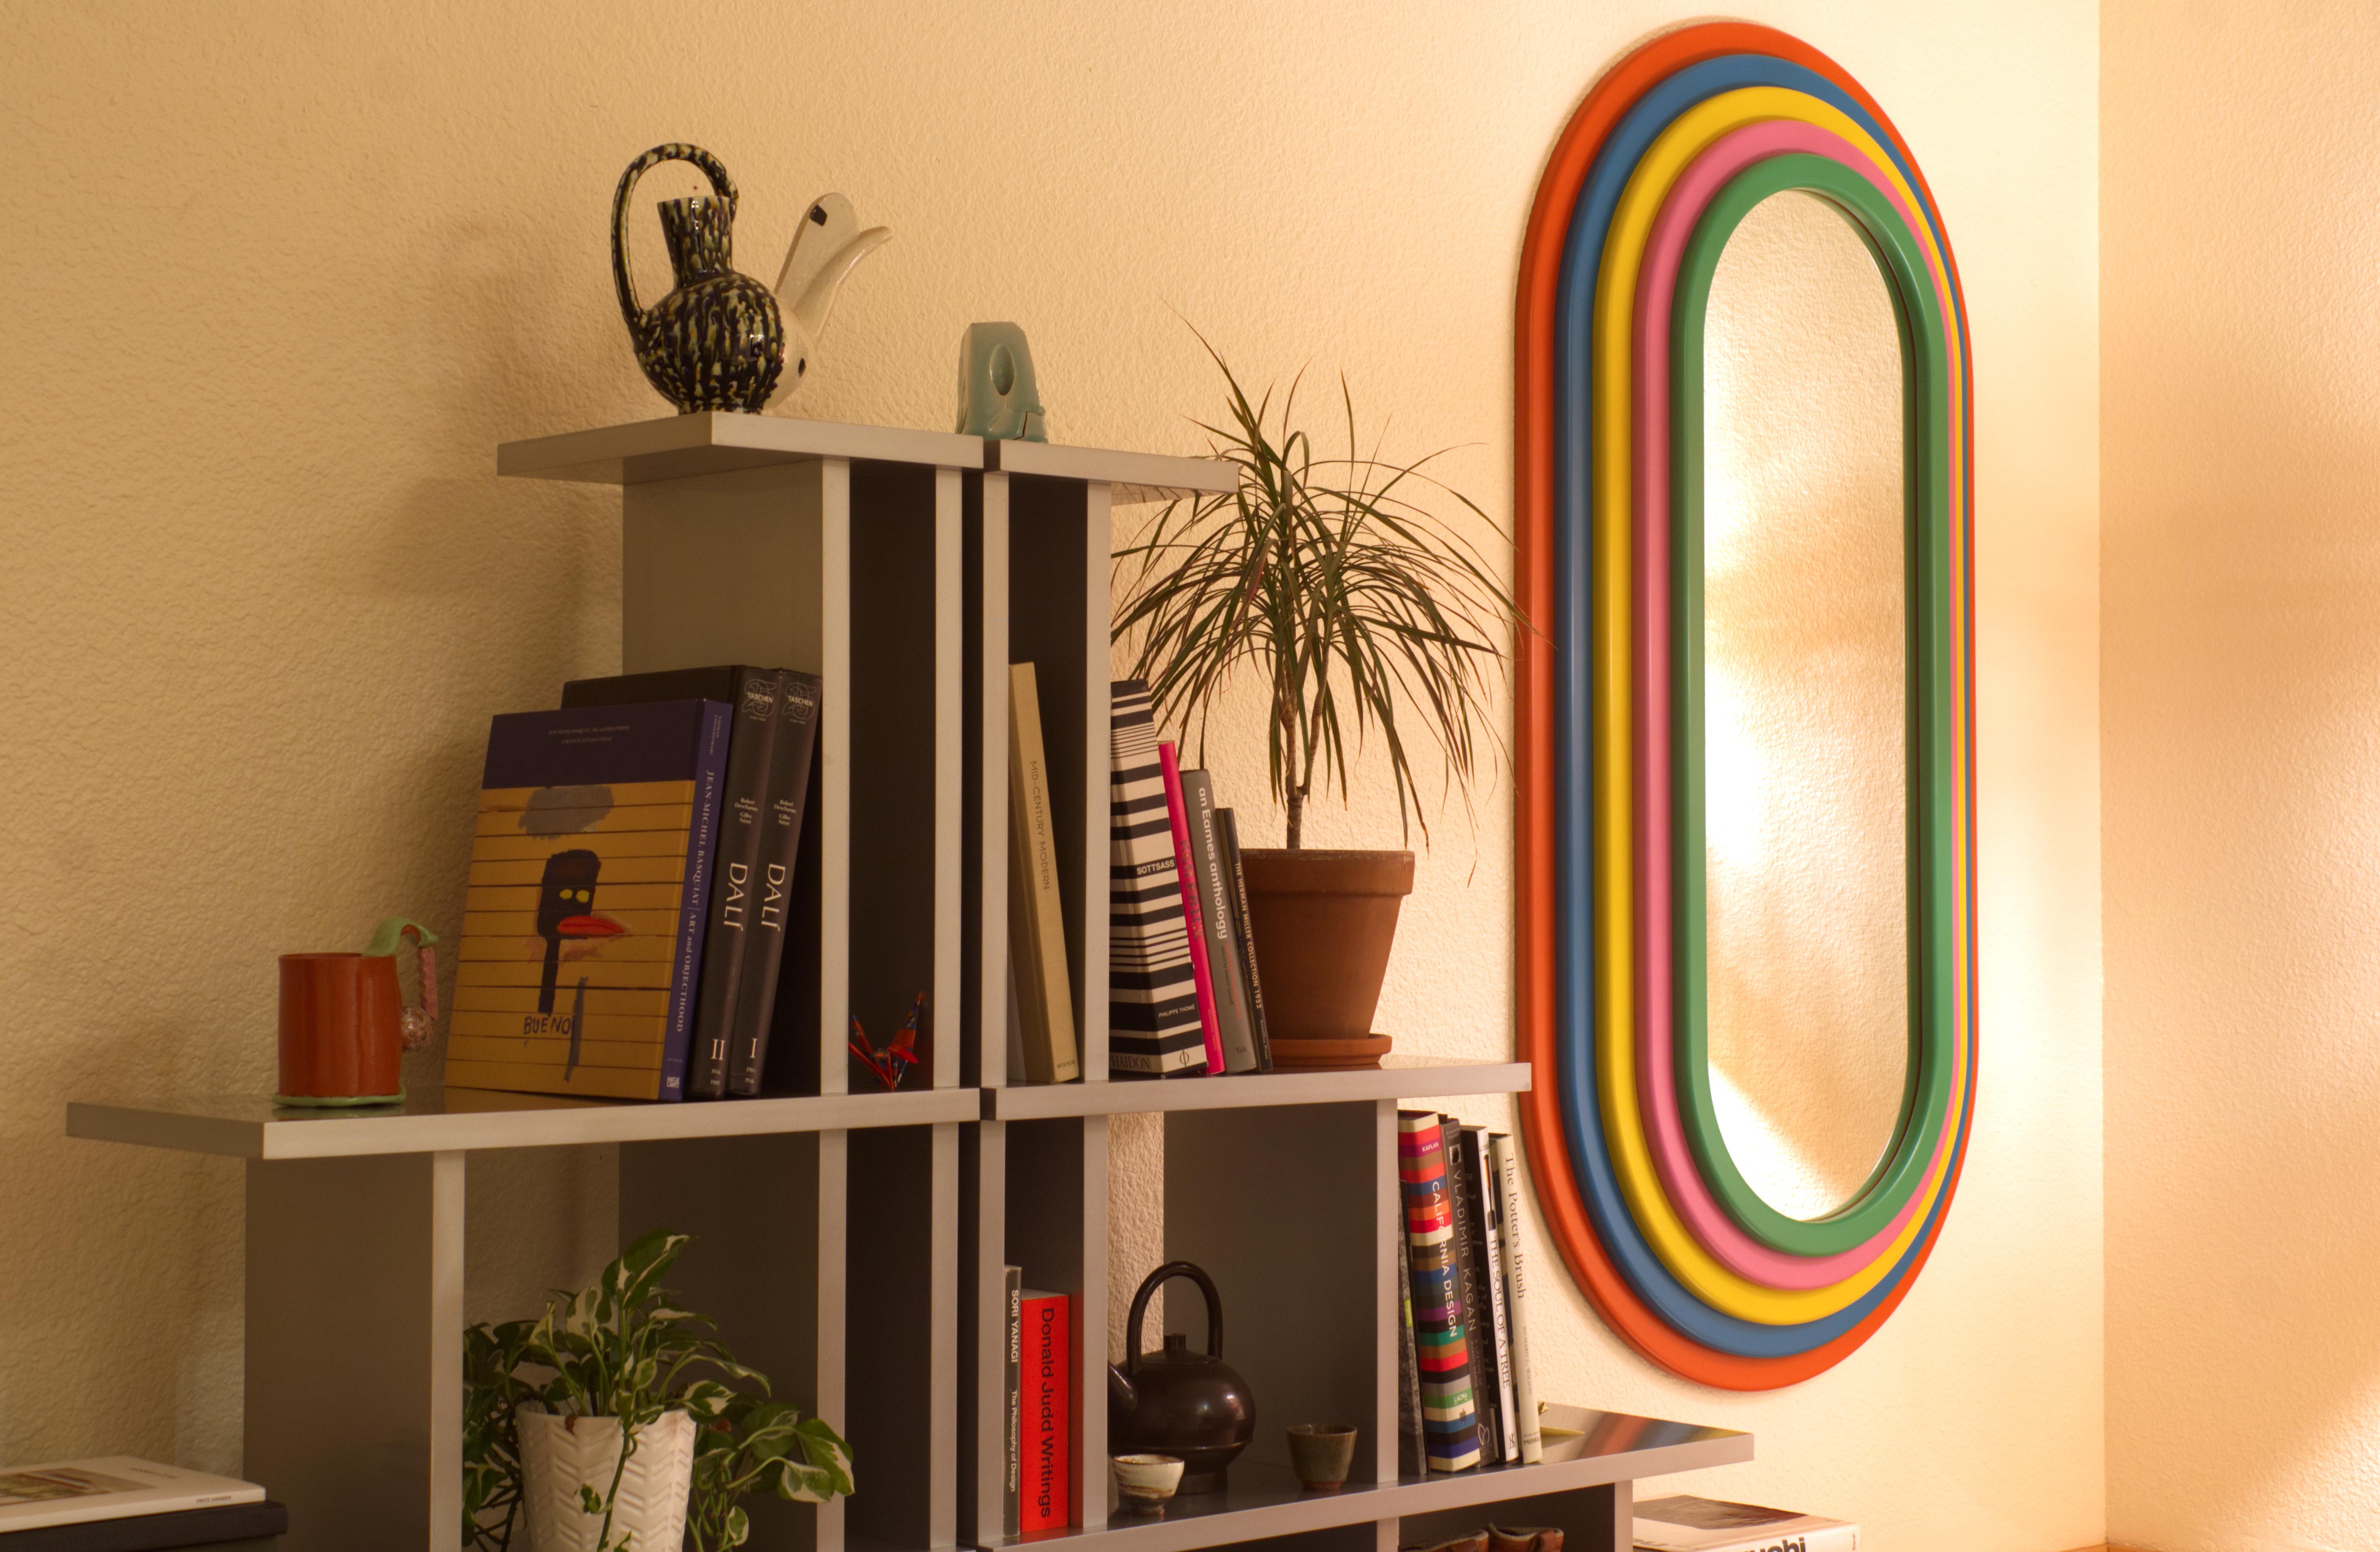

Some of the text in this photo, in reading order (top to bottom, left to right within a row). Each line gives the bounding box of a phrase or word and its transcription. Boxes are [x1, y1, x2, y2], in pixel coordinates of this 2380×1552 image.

[747, 692, 773, 703] TASCHEN
[788, 695, 813, 707] TASCHEN
[734, 802, 758, 812] Descharnes
[773, 804, 796, 814] Descharnes
[780, 799, 794, 807] Robert
[1030, 761, 1050, 890] MID-CENTURY MODERN
[1136, 859, 1175, 875] SOTTSASS
[1199, 787, 1227, 939] an Eames anthology
[676, 771, 715, 1032] JEAN-MICHEL BASQUIAT ART and OBJECTHOOD
[724, 862, 748, 932] DALÍ
[761, 863, 786, 932] DALÍ
[1237, 879, 1247, 911] HERMAN
[1243, 913, 1251, 940] MILLER
[1247, 941, 1258, 987] COLLECTION
[1254, 989, 1262, 1009] 1952
[1159, 1004, 1195, 1018] PHILIPPE THOMÉ
[524, 1016, 571, 1035] BUENO
[1109, 1055, 1150, 1070] HAIDON
[1422, 1142, 1438, 1152] KAPLAN
[1506, 1152, 1526, 1300] The Potter's Brush
[1432, 1181, 1457, 1338] CALIFORNIA DESIGN
[1454, 1170, 1469, 1257] VLADIMIR
[1463, 1268, 1476, 1331] KAGAN
[1490, 1236, 1510, 1389] THE SOUL OF A TREE
[1454, 1392, 1468, 1404] LACMA
[1038, 1308, 1054, 1518] Donald Judd Writings
[1011, 1453, 1017, 1462] of
